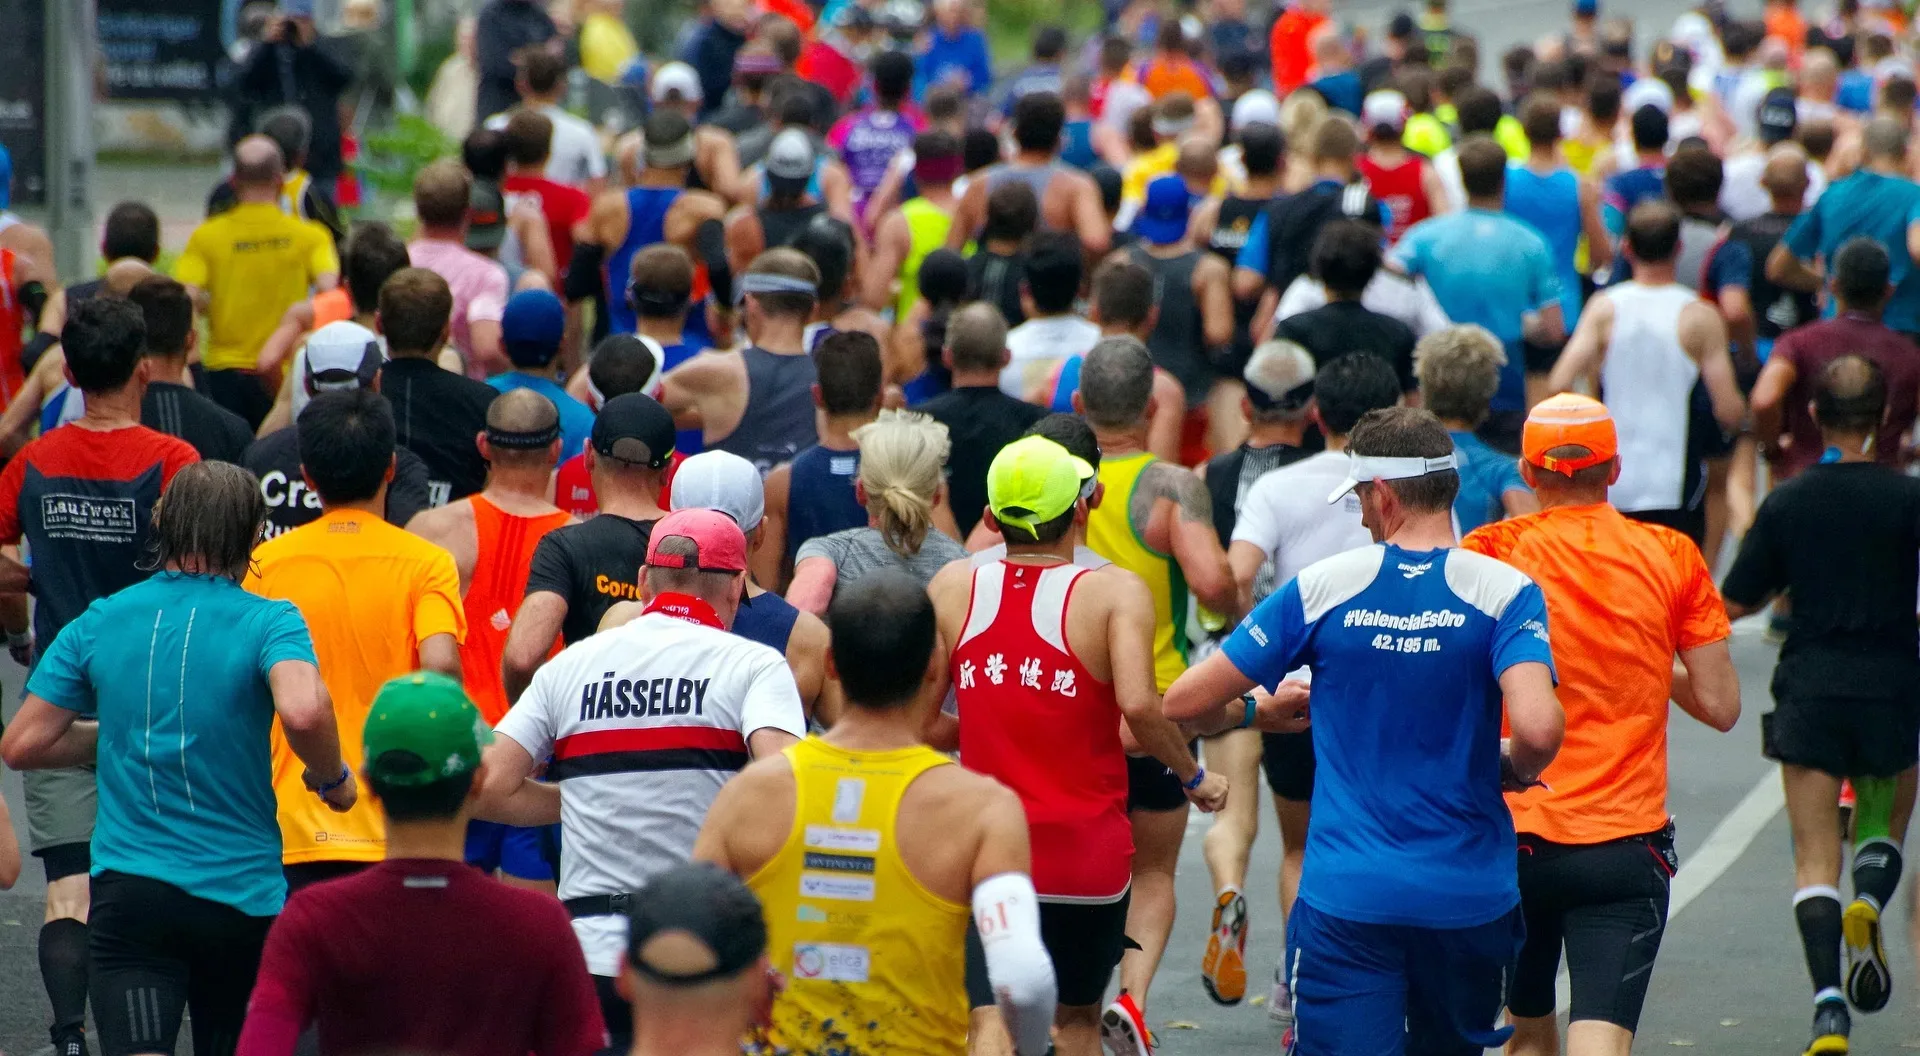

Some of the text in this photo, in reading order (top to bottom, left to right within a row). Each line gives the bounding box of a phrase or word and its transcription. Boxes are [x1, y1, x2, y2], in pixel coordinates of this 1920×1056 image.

[45, 500, 131, 519] Laufwerk
[1397, 562, 1433, 573] BROOKS
[1343, 608, 1466, 631] #ValenciaEsOro
[1371, 633, 1441, 653] 42.195 m.
[579, 670, 711, 722] HÄSSELBY
